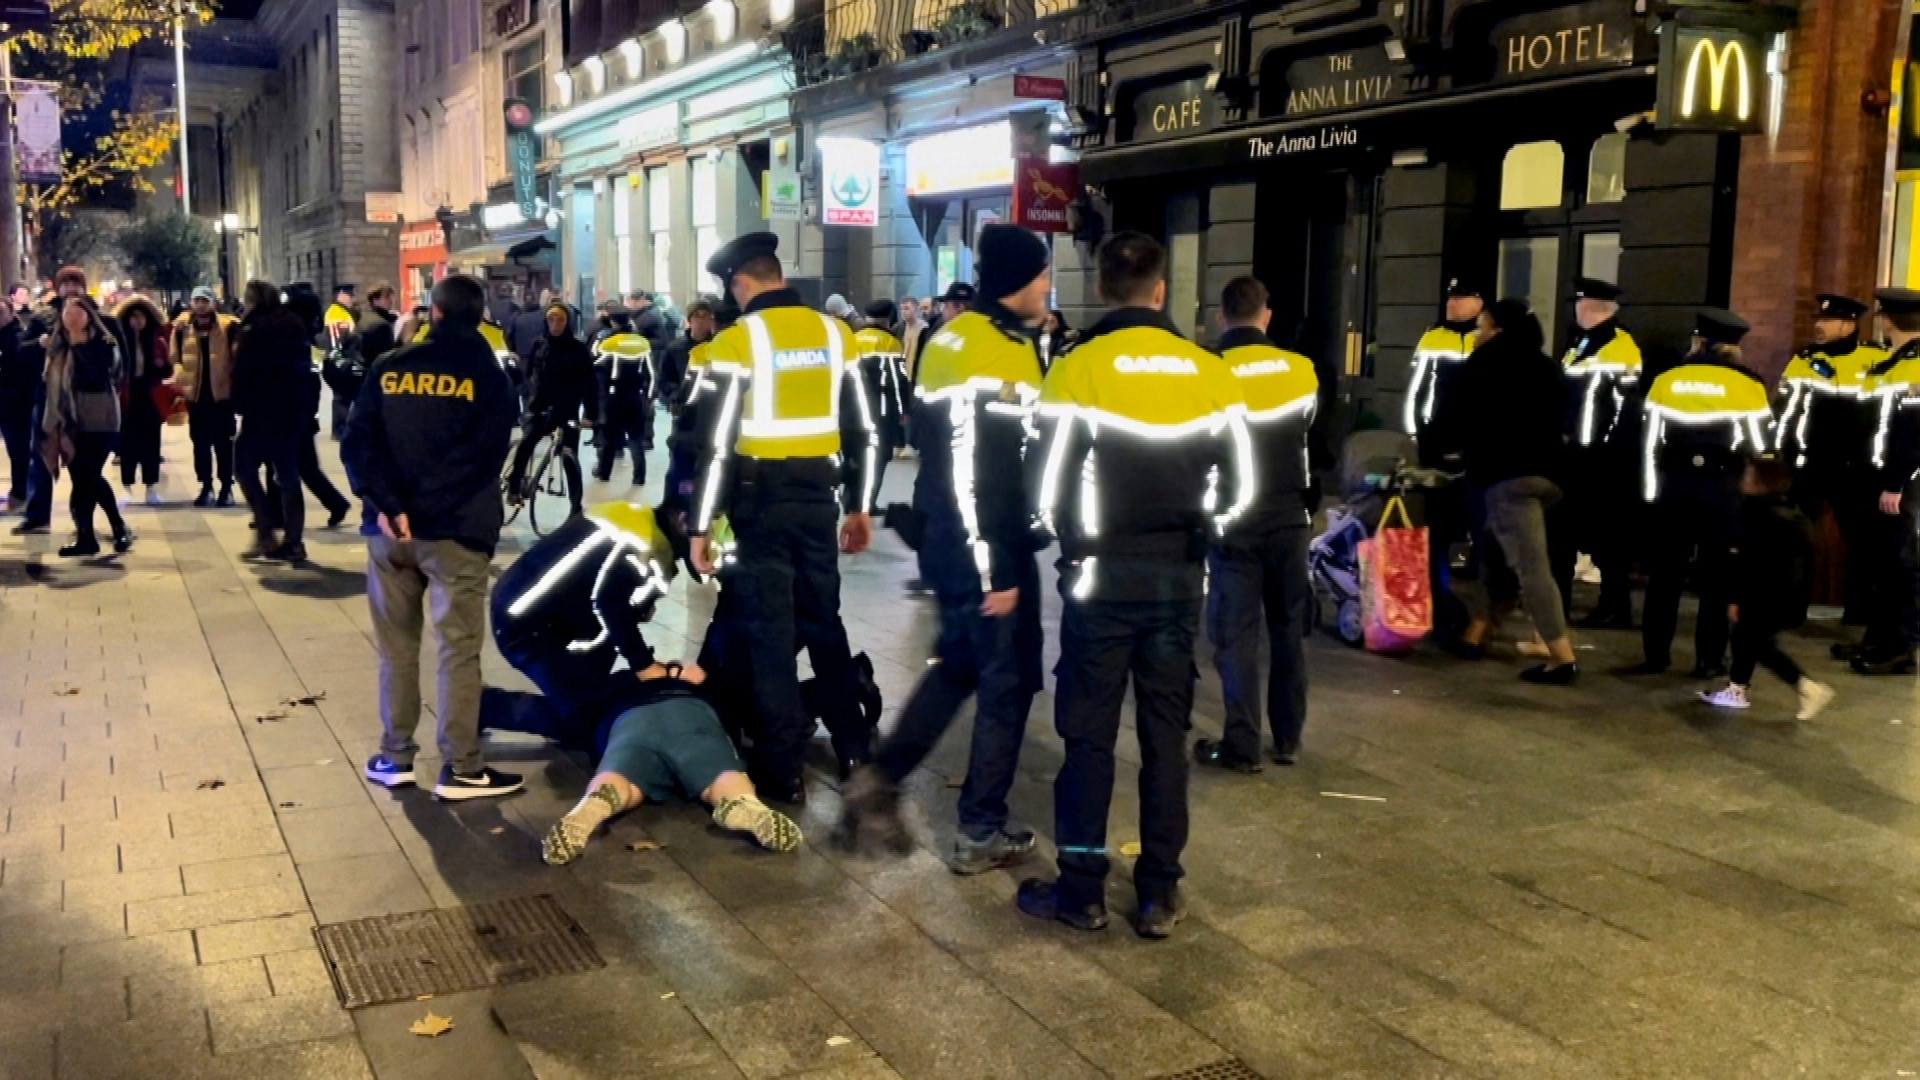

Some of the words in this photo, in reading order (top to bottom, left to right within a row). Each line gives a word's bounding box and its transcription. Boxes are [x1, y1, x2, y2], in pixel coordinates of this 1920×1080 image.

[1329, 54, 1353, 73] THE
[1508, 23, 1610, 74] HOTEL
[1153, 94, 1201, 132] CAFÉ
[1286, 85, 1338, 115] ANNA
[1248, 137, 1274, 158] The
[1276, 133, 1316, 154] Anna
[1320, 123, 1357, 149] Livia
[518, 132, 533, 216] DONUTS
[829, 209, 873, 223] SPAR
[1027, 207, 1068, 222] INSOMNI
[774, 349, 827, 369] GARDA
[1112, 354, 1199, 375] GARDA
[380, 370, 475, 403] GARDA
